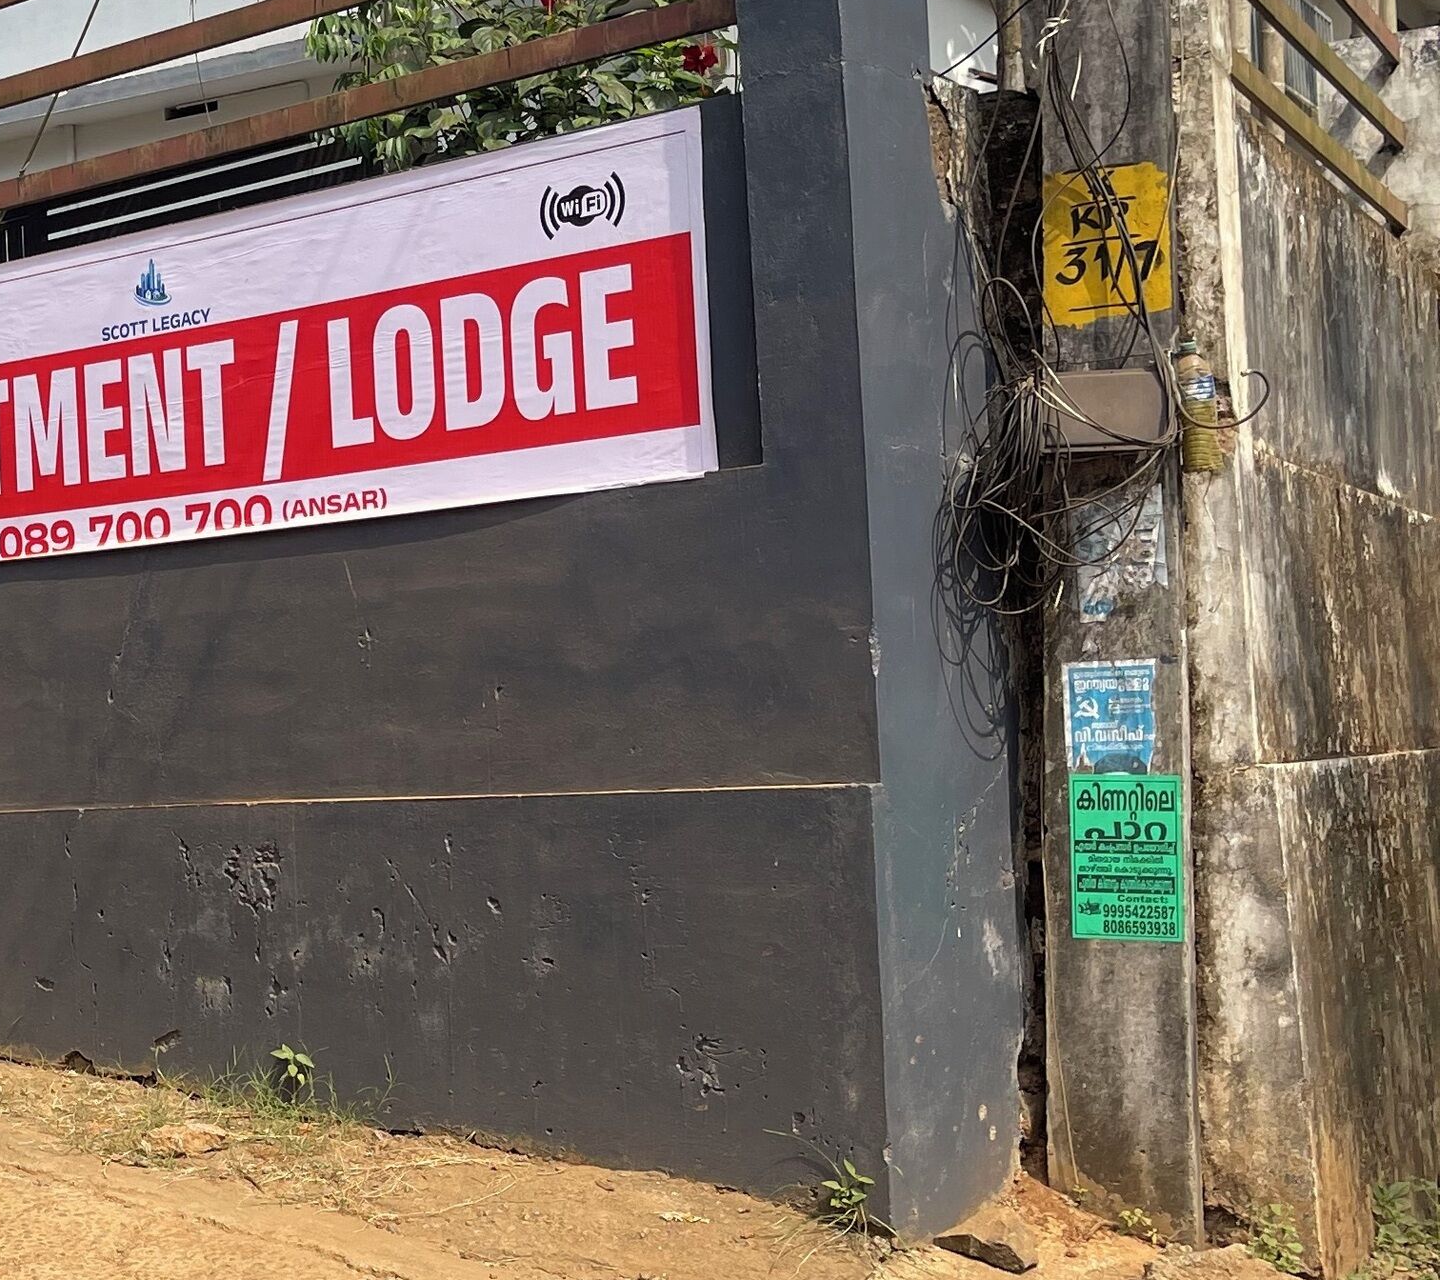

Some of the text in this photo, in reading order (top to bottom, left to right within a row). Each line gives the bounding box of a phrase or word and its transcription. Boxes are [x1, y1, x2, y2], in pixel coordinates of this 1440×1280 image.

[102, 308, 210, 342] SCOTT LEGACY
[263, 320, 299, 480] /
[325, 262, 639, 450] LODGE
[89, 508, 171, 547] 700
[185, 495, 272, 534] 700
[282, 488, 387, 522] (ANSAR)
[1076, 782, 1174, 821] കിണറ്റിലെ
[1084, 821, 1167, 840] പാറ
[1103, 904, 1176, 920] 9995422587
[1117, 894, 1169, 904] Contact:
[1103, 919, 1176, 936] 8086593938
